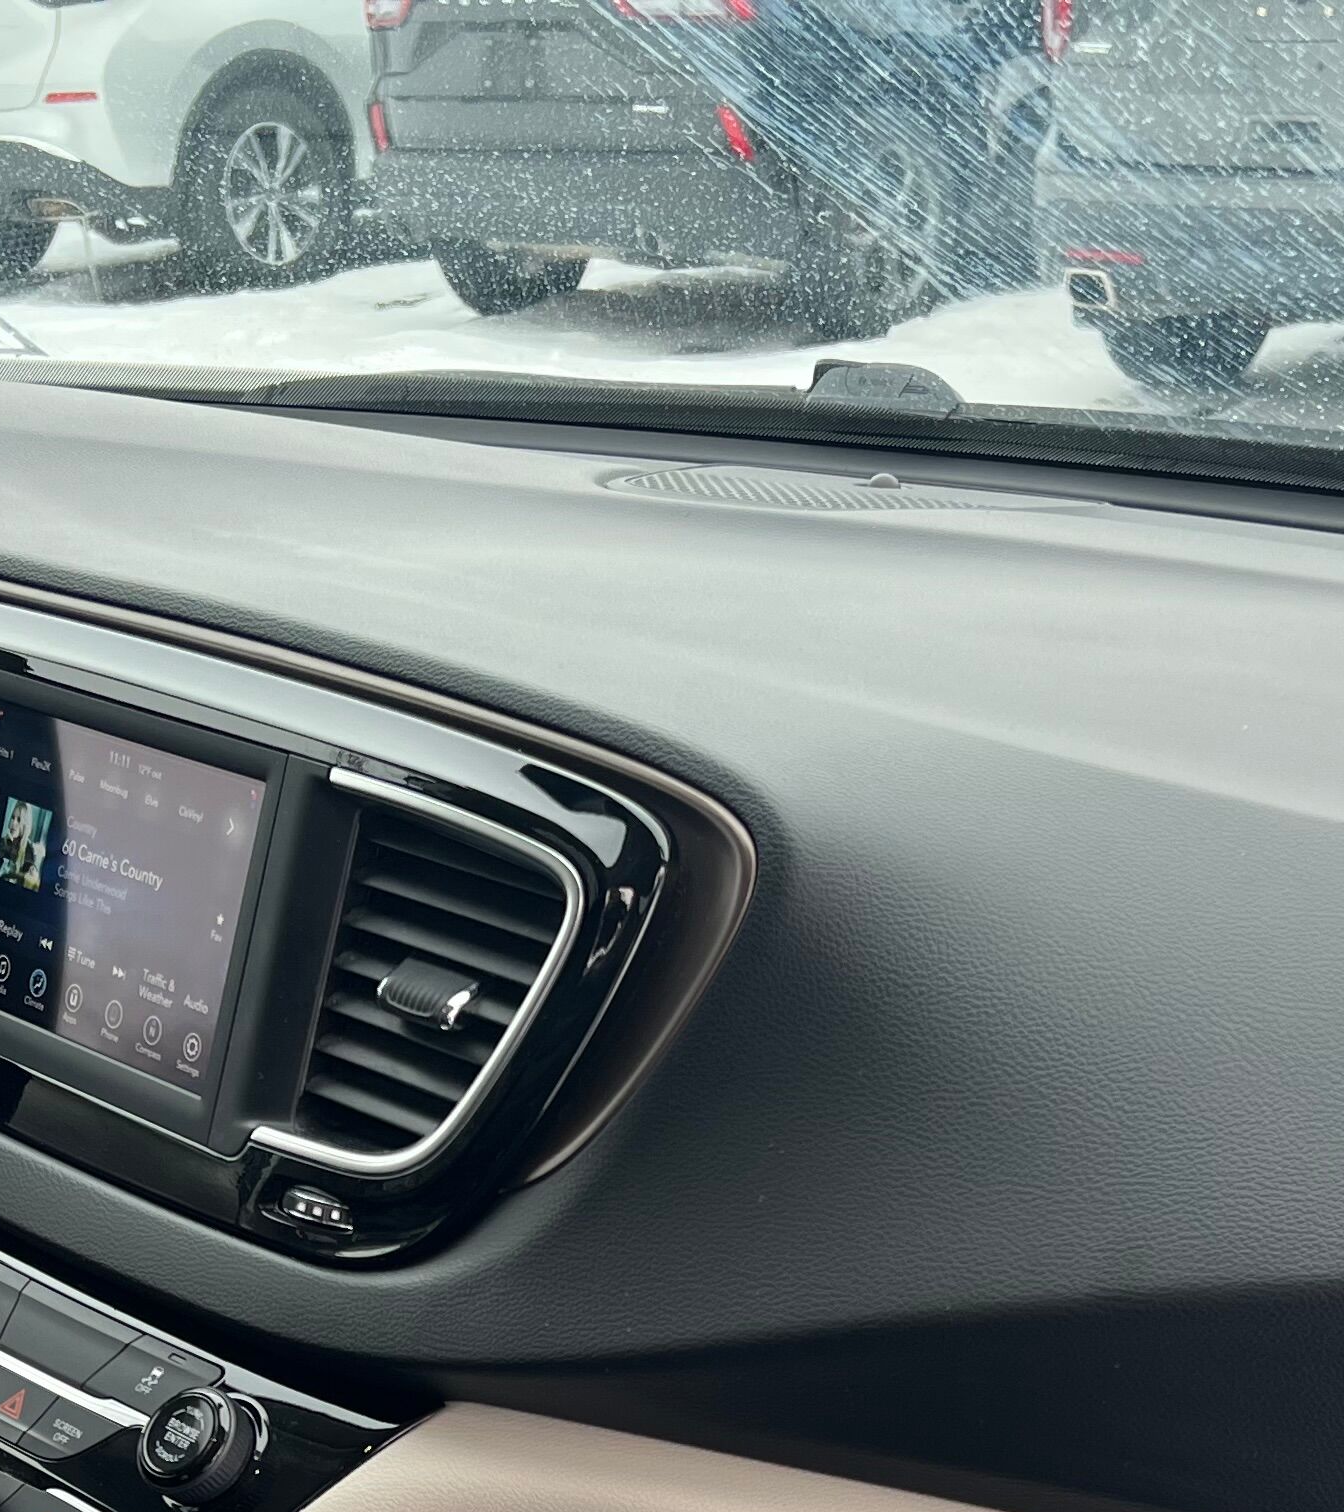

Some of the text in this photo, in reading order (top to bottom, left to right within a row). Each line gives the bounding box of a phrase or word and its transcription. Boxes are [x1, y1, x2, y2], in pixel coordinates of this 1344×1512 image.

[109, 751, 131, 768] 11:11
[67, 815, 97, 838] Country
[62, 838, 164, 892] 60 Carrie's Country
[82, 872, 128, 901] Underwood
[54, 883, 112, 914] Songs Like This
[211, 929, 223, 943] Fav
[76, 950, 96, 969] Tune
[143, 968, 175, 993] Traffic &
[23, 995, 45, 1012] Climate
[139, 984, 174, 1008] Weather
[183, 994, 209, 1015] Audio
[100, 1027, 120, 1043] Phone
[135, 1042, 162, 1062] Compass
[176, 1060, 200, 1078] Settings
[134, 1382, 153, 1395] OFF
[52, 1418, 84, 1439] SCREEN
[167, 1417, 201, 1440] BROWSE
[52, 1432, 69, 1446] OFF
[164, 1431, 191, 1450] ENTER
